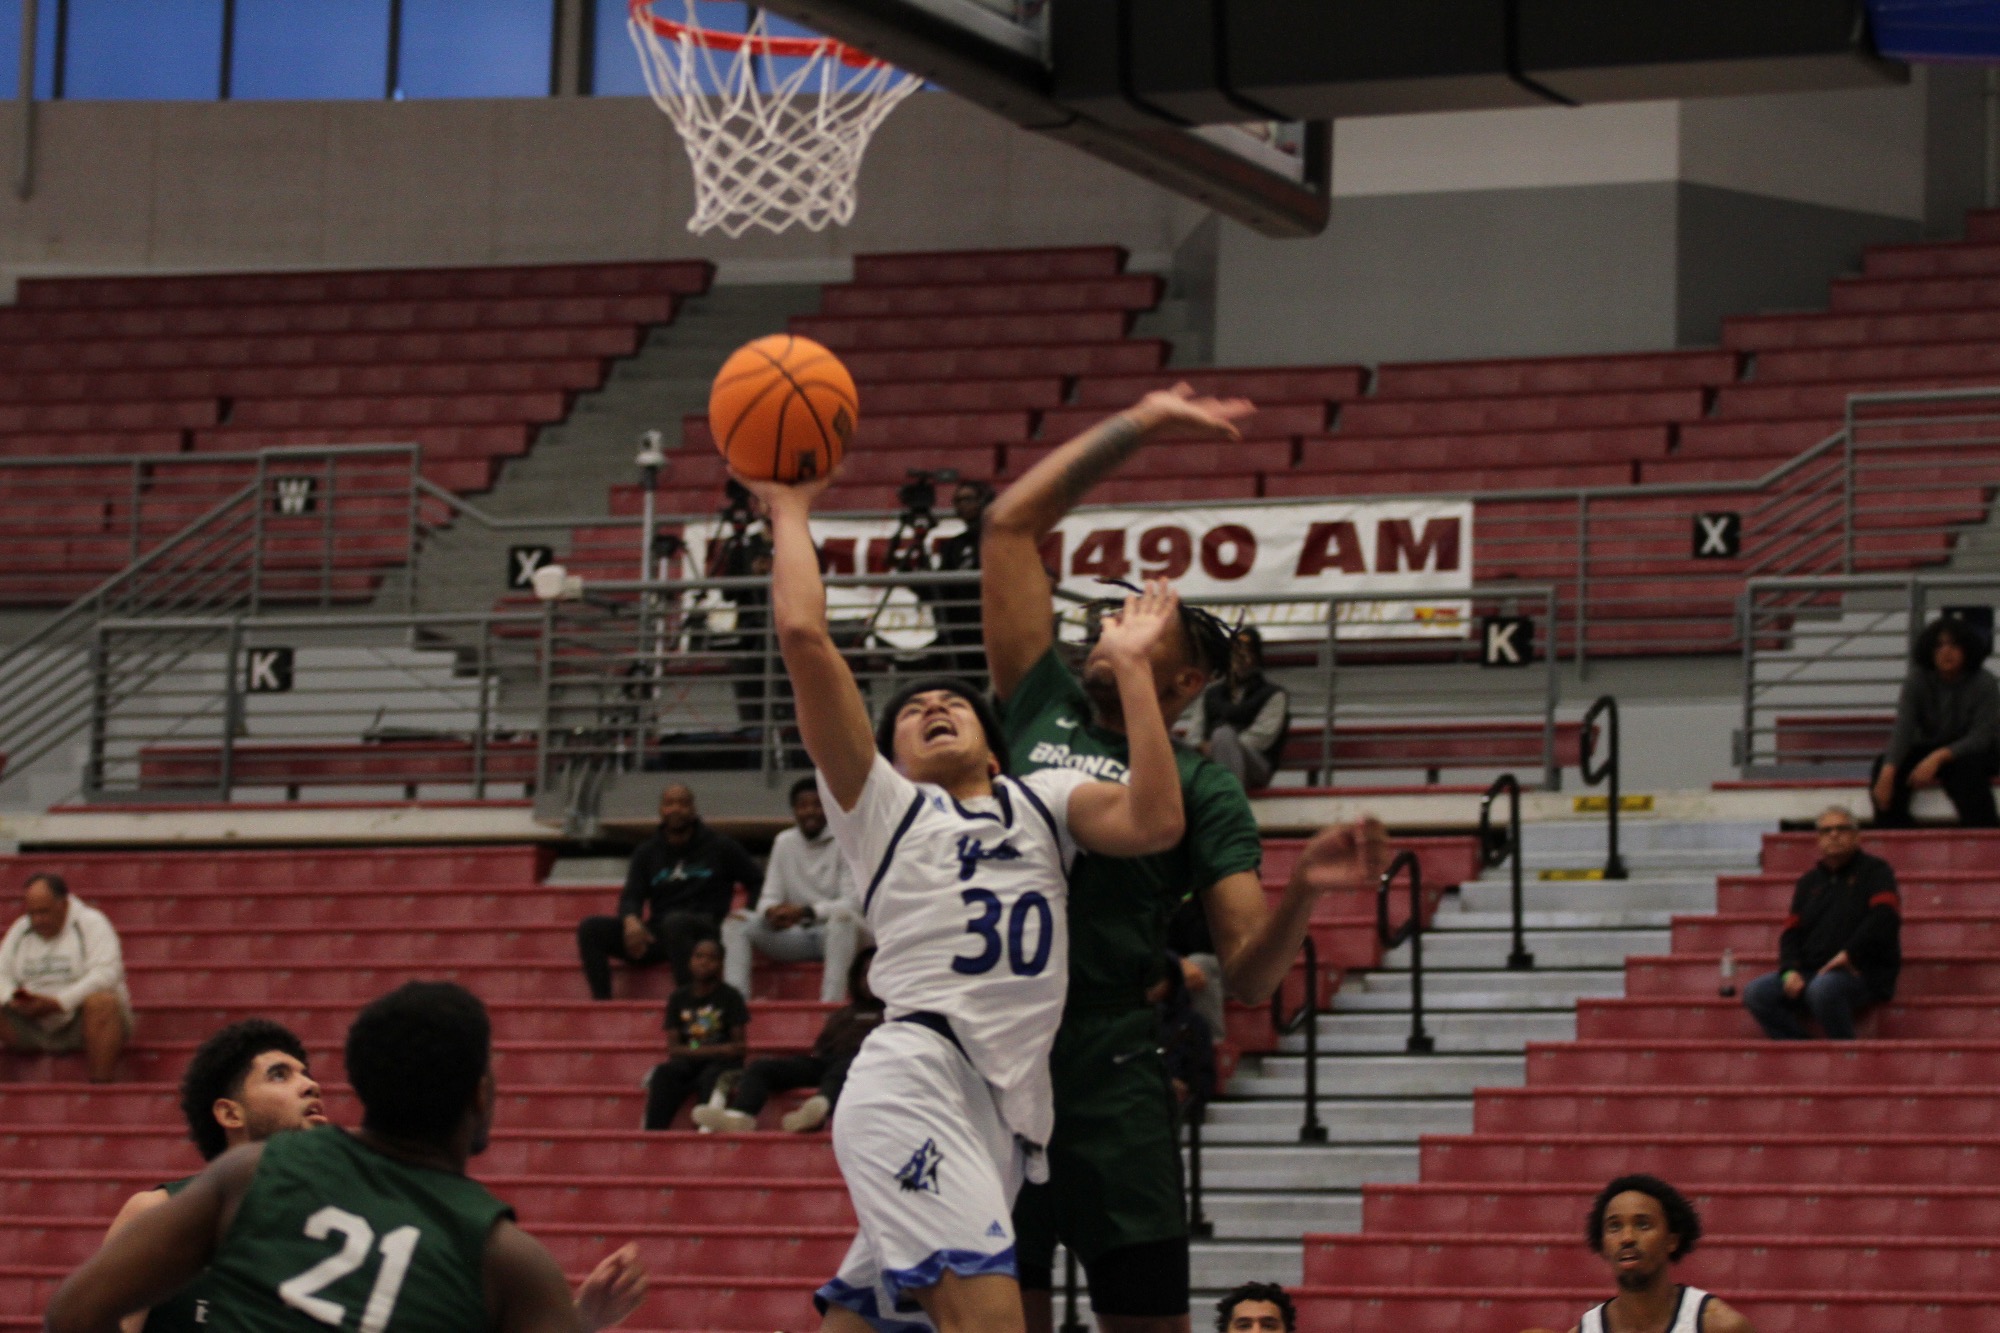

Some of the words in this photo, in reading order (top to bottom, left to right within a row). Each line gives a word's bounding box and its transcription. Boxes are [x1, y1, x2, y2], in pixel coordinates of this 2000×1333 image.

[277, 479, 310, 515] W
[1039, 524, 1258, 584] 1490
[1295, 516, 1461, 577] AM
[1700, 516, 1729, 555] X
[516, 549, 543, 585] X
[1487, 622, 1520, 664] K
[251, 651, 280, 690] K
[951, 887, 1053, 977] 30
[278, 1205, 422, 1333] 21
